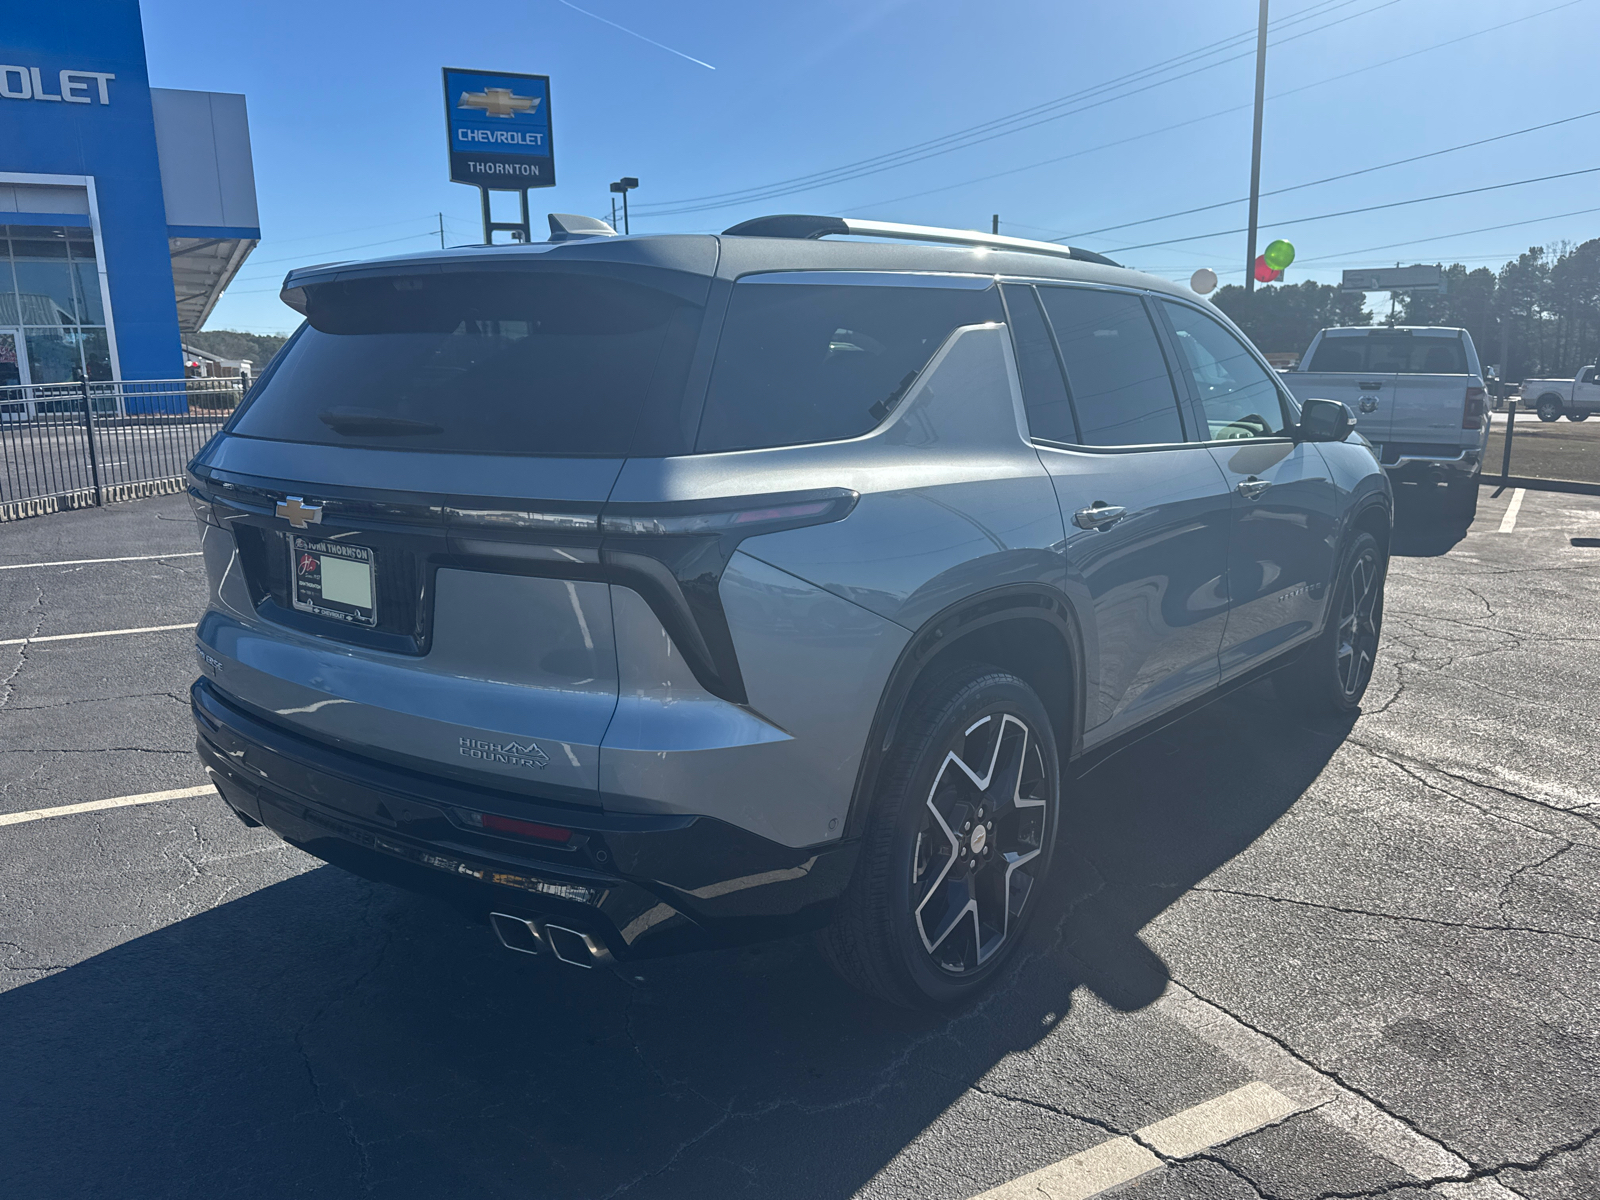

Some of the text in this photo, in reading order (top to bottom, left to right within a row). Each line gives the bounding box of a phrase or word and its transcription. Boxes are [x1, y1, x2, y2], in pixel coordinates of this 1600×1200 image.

[458, 128, 544, 146] CHEVROLET
[467, 161, 540, 176] THORNTON
[321, 609, 345, 619] CHEVROLET
[459, 736, 503, 753] HIGH
[459, 747, 548, 769] COUNTRY
